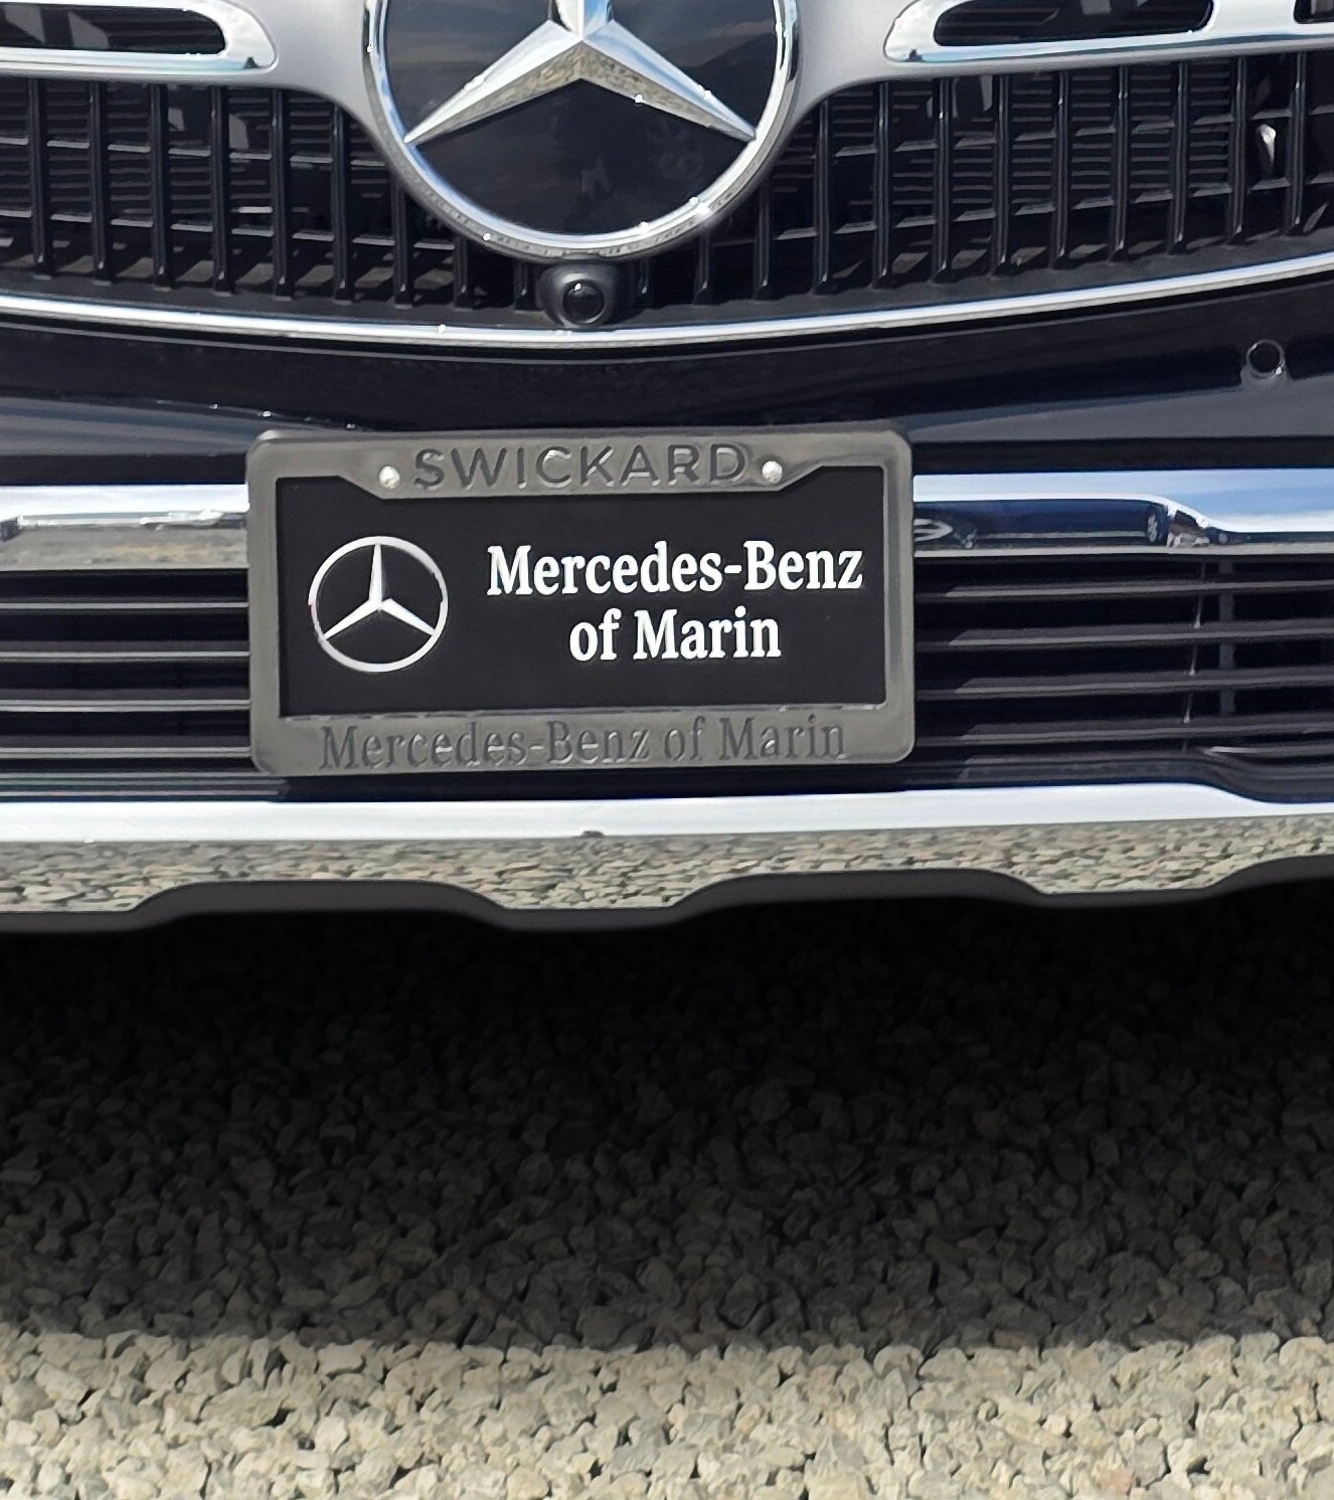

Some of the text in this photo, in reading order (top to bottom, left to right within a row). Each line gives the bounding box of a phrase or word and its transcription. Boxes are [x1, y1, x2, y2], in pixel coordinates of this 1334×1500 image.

[414, 443, 746, 491] SWICKARD
[487, 540, 864, 596] Mercedes-Benz
[569, 606, 782, 661] of Marin
[319, 712, 848, 771] Mercedes-Benz of Marin
